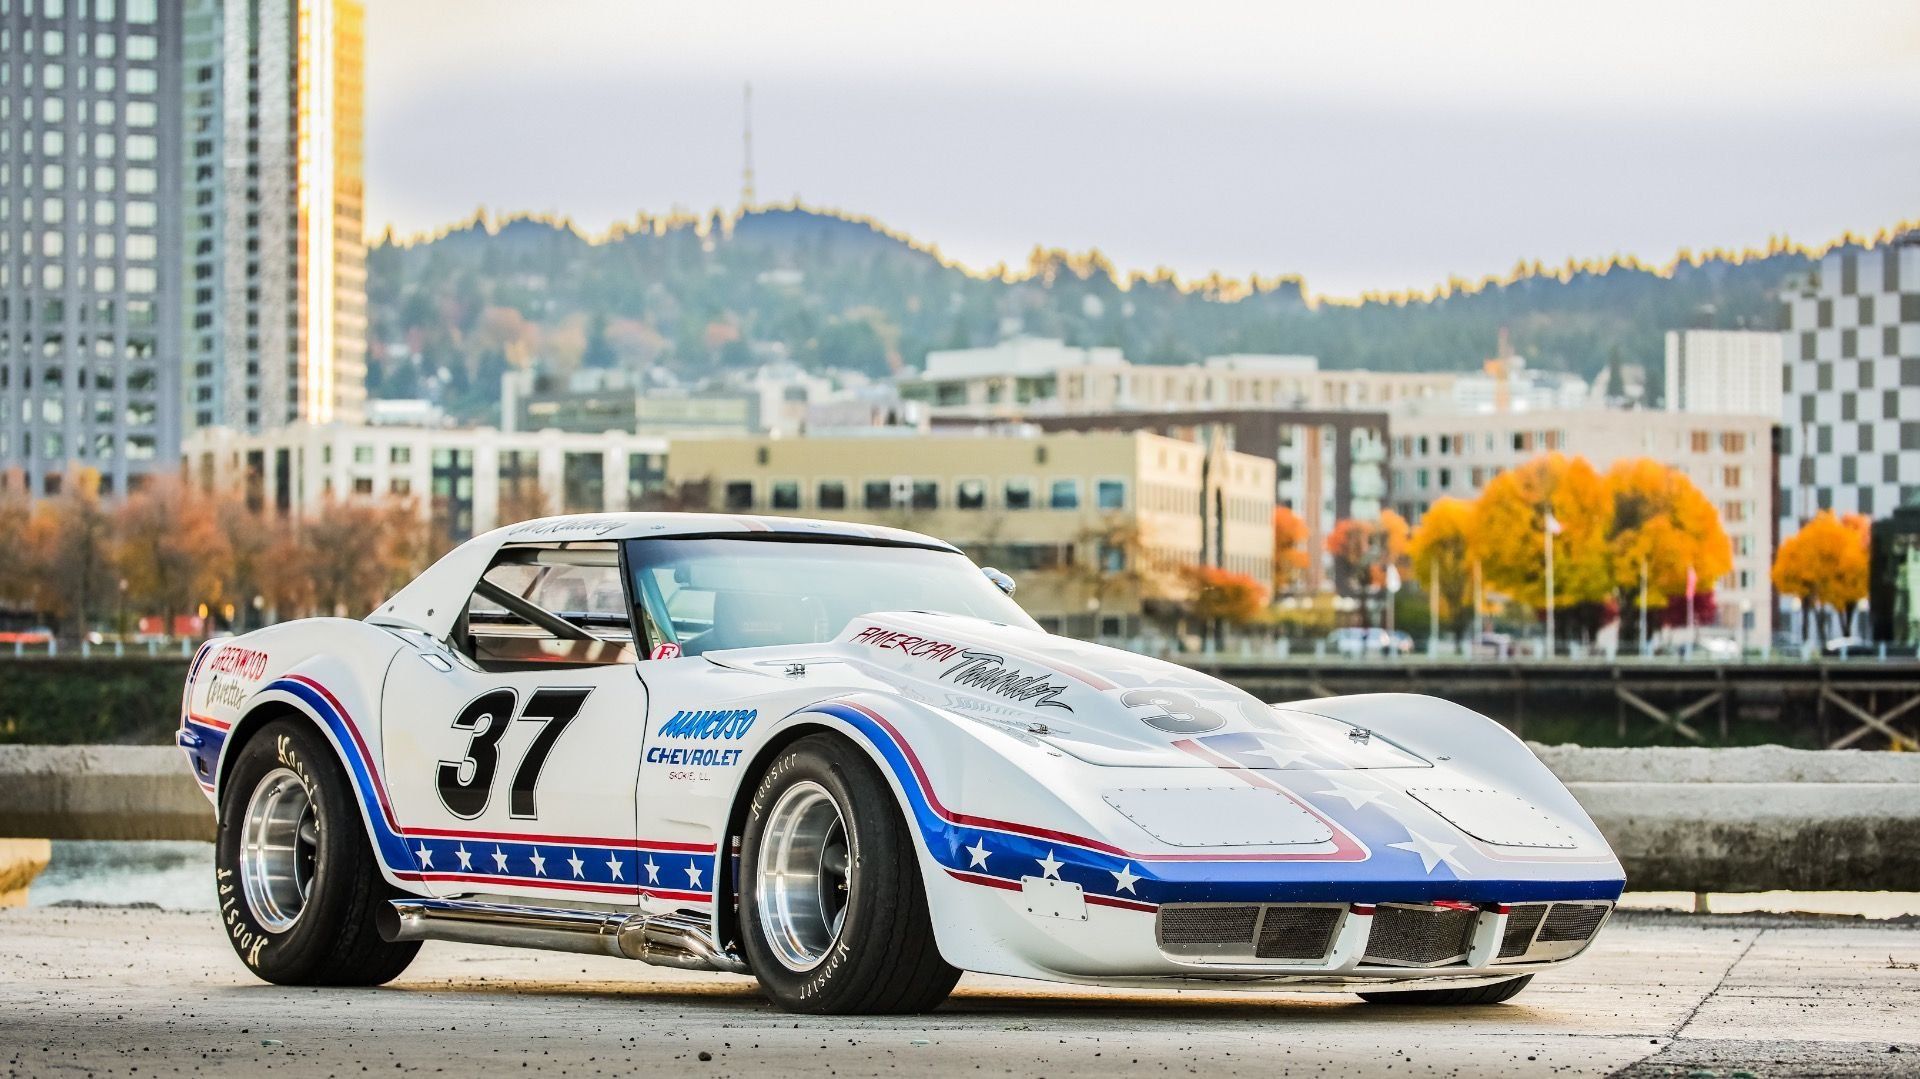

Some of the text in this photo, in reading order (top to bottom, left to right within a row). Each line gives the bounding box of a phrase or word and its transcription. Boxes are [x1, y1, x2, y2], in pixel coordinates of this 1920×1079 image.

[210, 646, 268, 681] GREENWOOD
[849, 626, 966, 663] AMERICAN
[938, 650, 1074, 714] Thunder
[435, 686, 597, 820] 37
[657, 708, 758, 741] MANCUSO
[646, 747, 742, 767] CHEVROLET
[751, 752, 797, 821] Hoosier
[216, 867, 269, 968] Hoosier
[799, 943, 850, 1000] Hoosier
